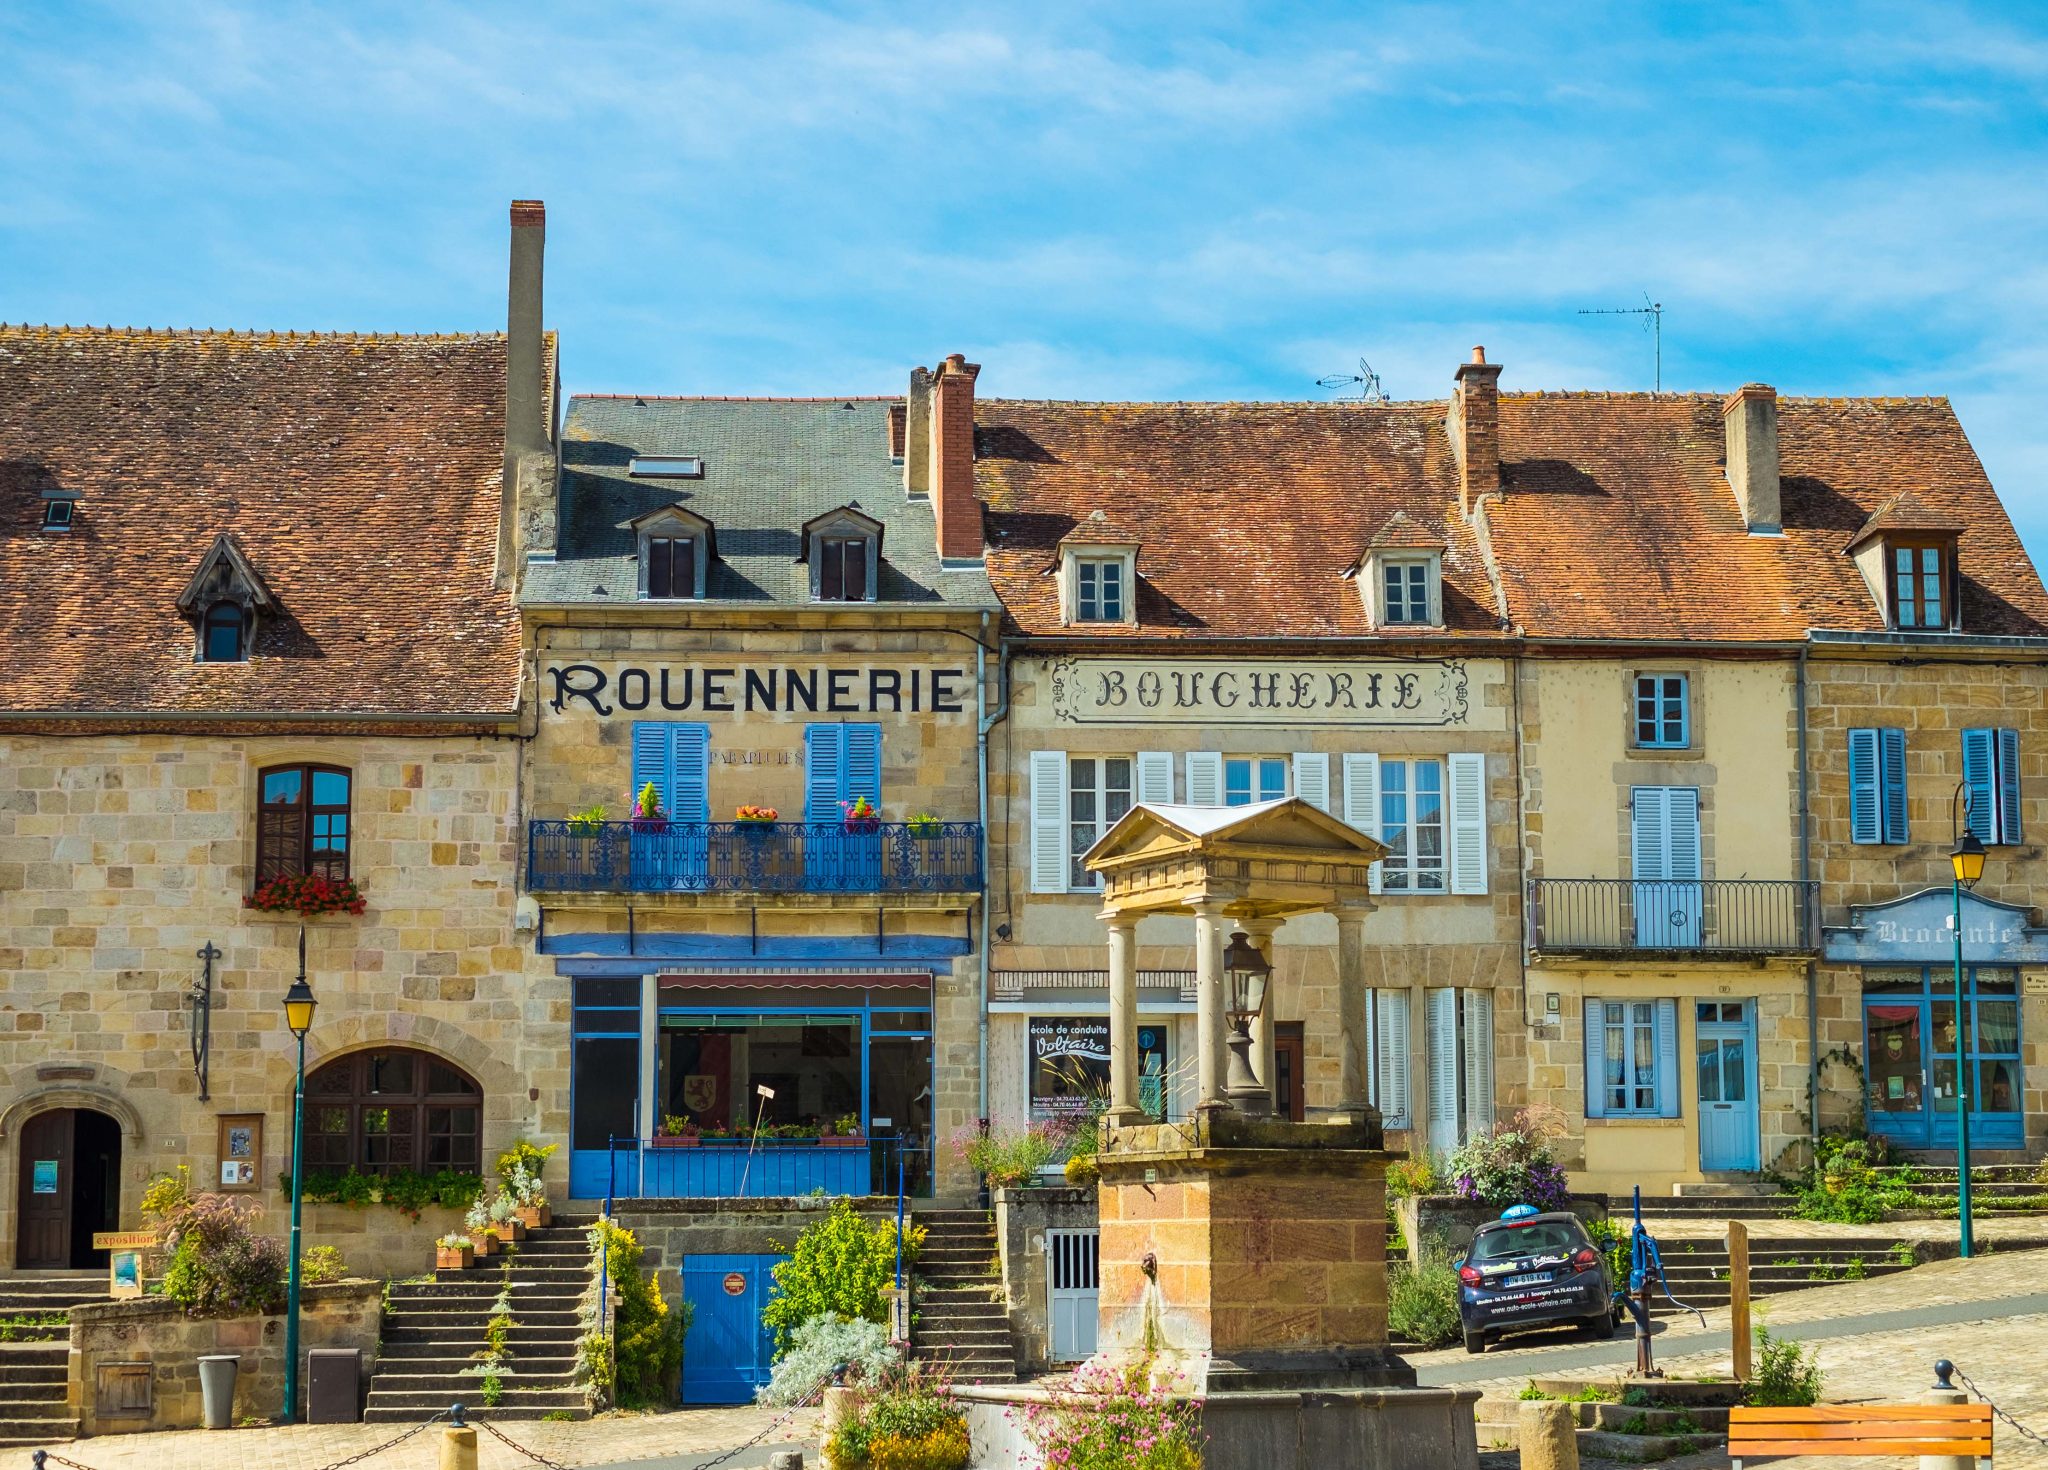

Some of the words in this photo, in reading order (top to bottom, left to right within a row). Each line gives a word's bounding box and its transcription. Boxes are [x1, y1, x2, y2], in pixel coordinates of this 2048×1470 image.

[547, 665, 963, 717] ROUENNERIE
[1096, 671, 1423, 709] BOUCHERIE
[1876, 920, 2012, 943] Brocnte
[1031, 1025, 1054, 1034] école
[1056, 1025, 1068, 1034] de
[1070, 1025, 1108, 1034] conduite
[1036, 1035, 1105, 1055] Voltaire
[96, 1234, 153, 1246] exposition
[1491, 1299, 1573, 1314] www.auto-ecole-voltaire.com
